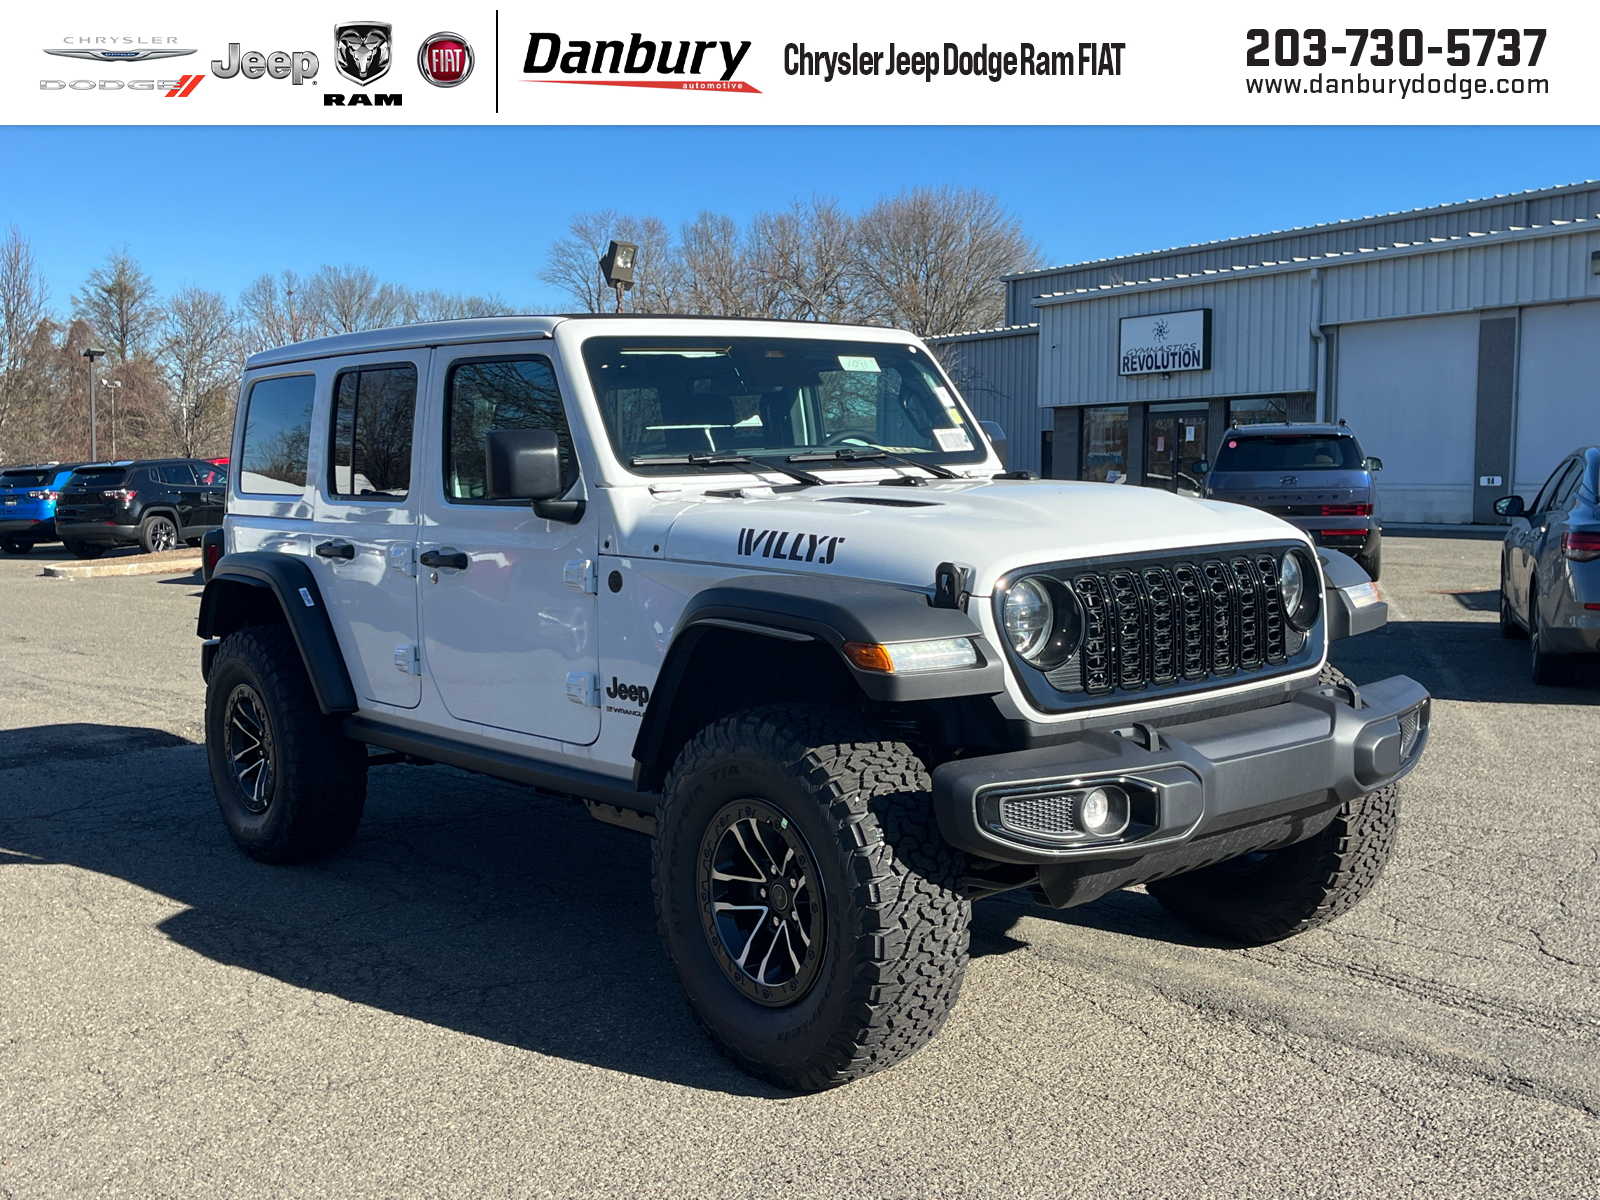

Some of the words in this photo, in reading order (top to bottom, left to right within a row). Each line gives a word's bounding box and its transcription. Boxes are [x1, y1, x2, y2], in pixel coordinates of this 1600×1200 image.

[1122, 349, 1201, 373] REVOLUTION
[1125, 342, 1198, 358] GYMNASTICS
[1487, 477, 1495, 485] 14
[737, 527, 846, 565] WILLYS
[606, 676, 650, 708] Jeep
